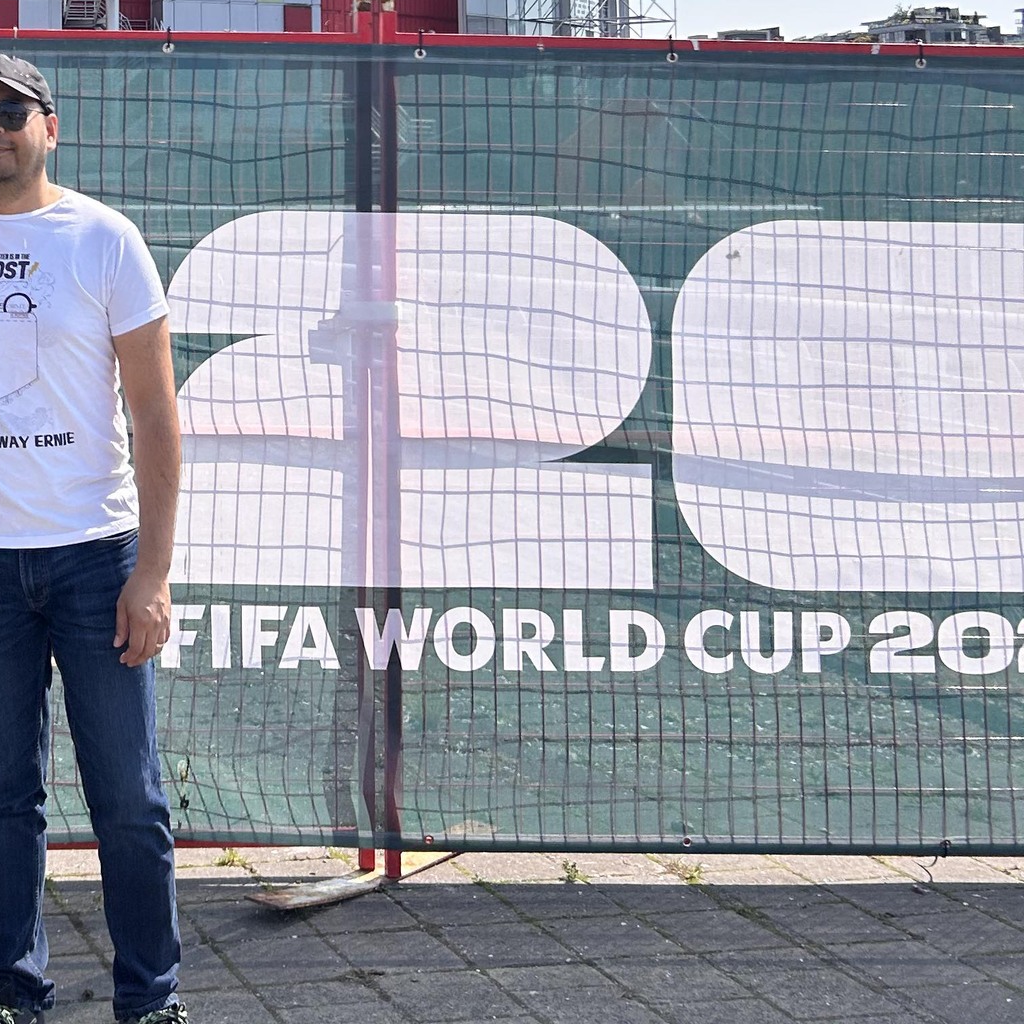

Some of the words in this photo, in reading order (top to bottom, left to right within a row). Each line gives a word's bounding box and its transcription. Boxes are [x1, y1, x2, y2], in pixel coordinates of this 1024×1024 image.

[34, 431, 75, 448] ERNIE
[160, 604, 341, 670] FIFA
[354, 607, 666, 673] WORLD
[684, 609, 851, 674] CUP
[868, 610, 1024, 675] 20
